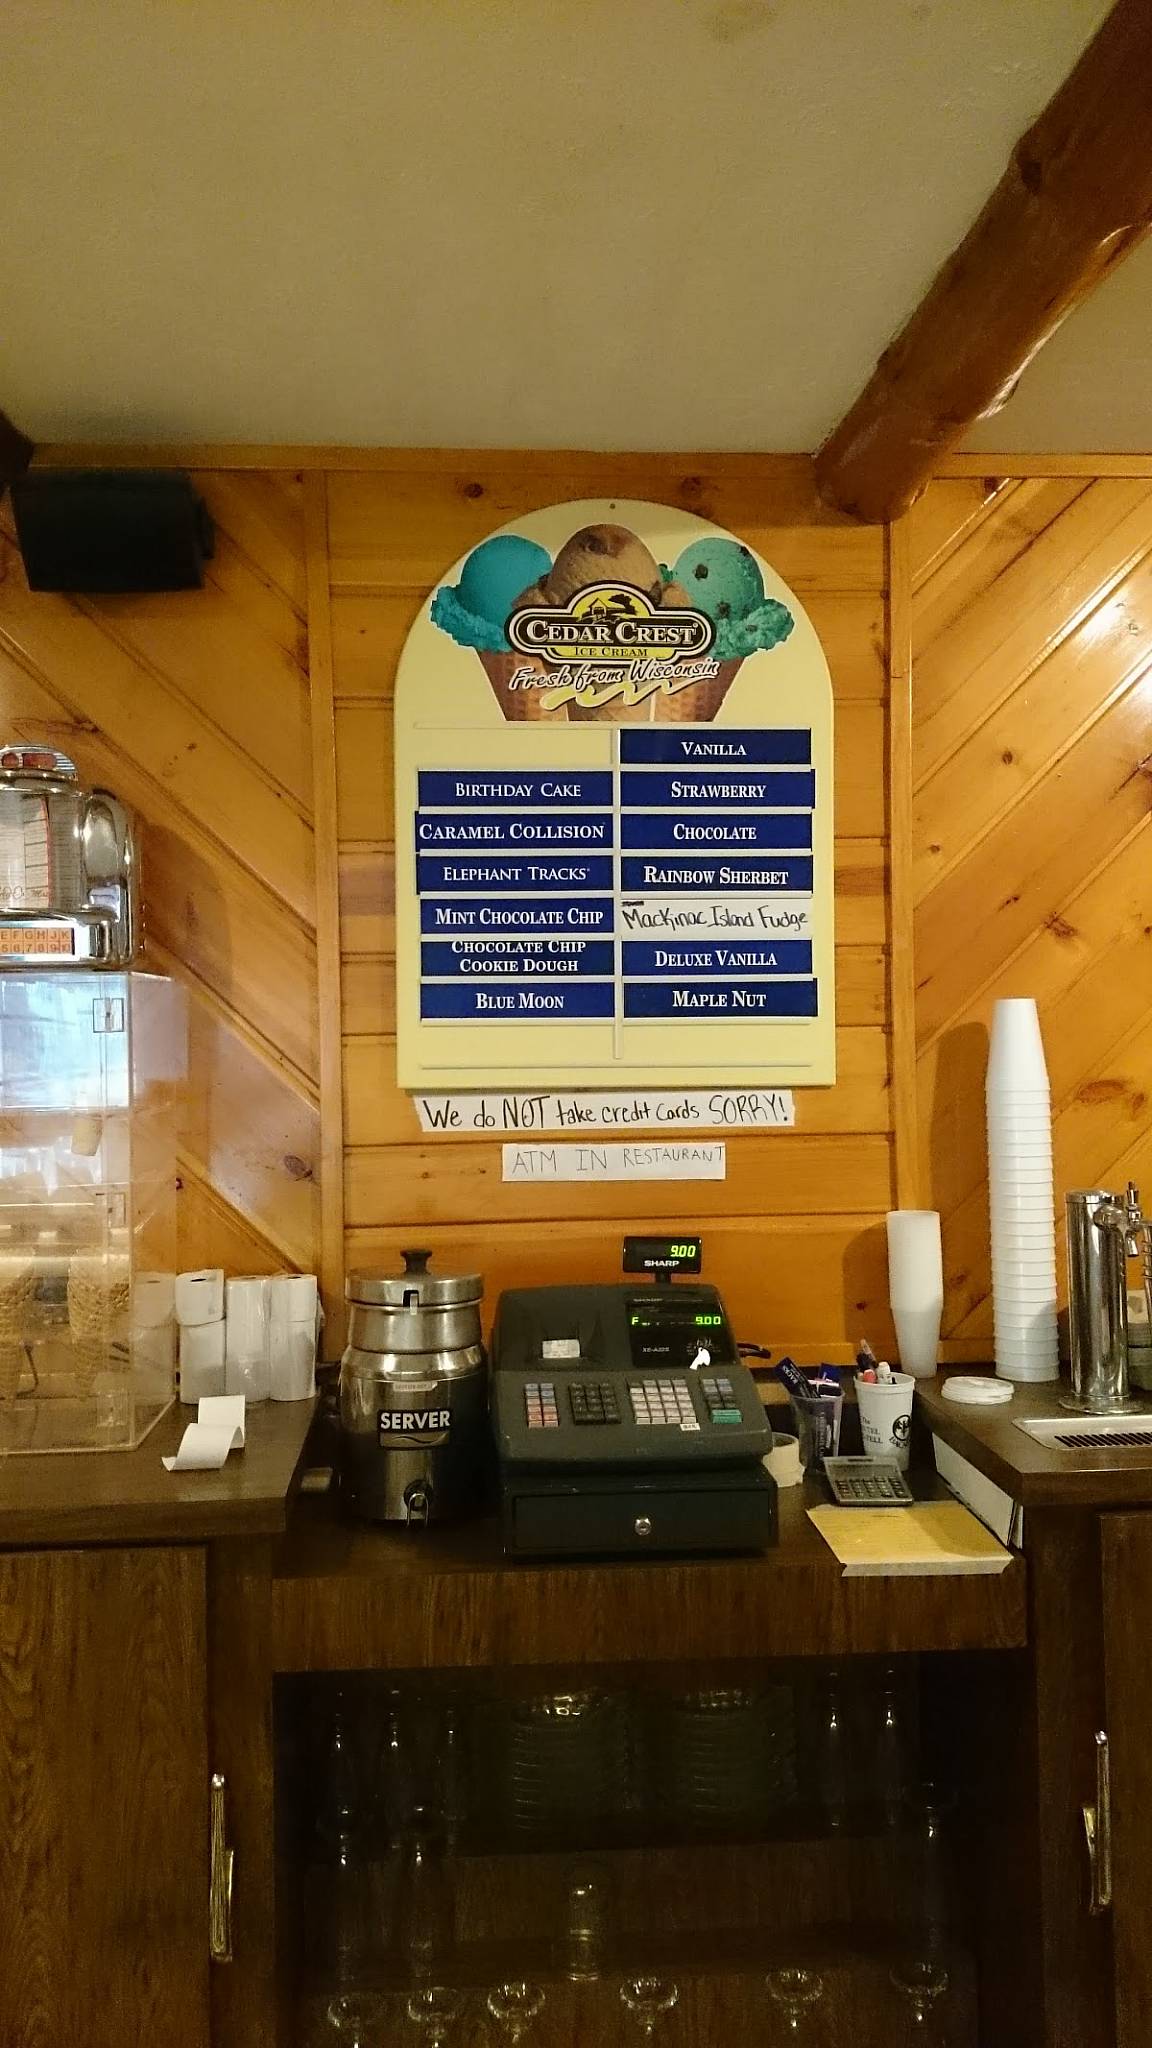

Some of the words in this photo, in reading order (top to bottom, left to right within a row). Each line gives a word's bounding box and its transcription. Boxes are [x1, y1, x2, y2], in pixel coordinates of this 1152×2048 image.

[526, 620, 613, 644] CEDAR
[615, 621, 697, 644] CREST
[575, 647, 597, 656] ICE
[601, 647, 648, 657] CREAM
[509, 664, 572, 690] Fresh
[574, 663, 624, 692] from
[629, 658, 719, 682] Wisconsin
[681, 741, 747, 756] VANILLA
[455, 782, 533, 797] BIRTHDAY
[540, 782, 581, 797] CAKE
[671, 781, 766, 798] STRAWBERRY
[419, 823, 504, 839] CARAMEL
[509, 823, 604, 839] COLLISION
[673, 823, 757, 840] CHOCOLATE
[443, 867, 522, 881] ELEPHANT
[527, 866, 588, 880] TRACKS
[643, 865, 715, 883] RAINBOW
[719, 866, 788, 884] SHERBET
[435, 908, 476, 925] MINT
[479, 908, 564, 925] CHOCOLATE
[567, 908, 603, 925] CHIP
[707, 905, 754, 928] Island
[758, 905, 808, 931] Fudge
[451, 941, 543, 953] CHOCOLATE
[548, 940, 586, 953] CHIP
[459, 958, 518, 972] COOKIE
[522, 958, 578, 972] DOUGH
[654, 950, 712, 967] DELUXE
[715, 950, 777, 966] VANILLA
[475, 992, 515, 1009] BLUE
[518, 992, 564, 1008] MOON
[672, 990, 728, 1007] MAPLE
[731, 990, 766, 1007] NUT
[423, 1099, 462, 1129] We
[473, 1100, 496, 1127] do
[502, 1095, 551, 1129] NOT
[556, 1099, 598, 1126] take
[601, 1099, 651, 1123] credit
[708, 1093, 789, 1126] SORRY!
[512, 1150, 558, 1175] ATM
[576, 1149, 608, 1172] IN
[623, 1146, 724, 1167] RESTAURANT
[631, 1316, 639, 1325] F
[380, 1410, 450, 1430] SERVER
